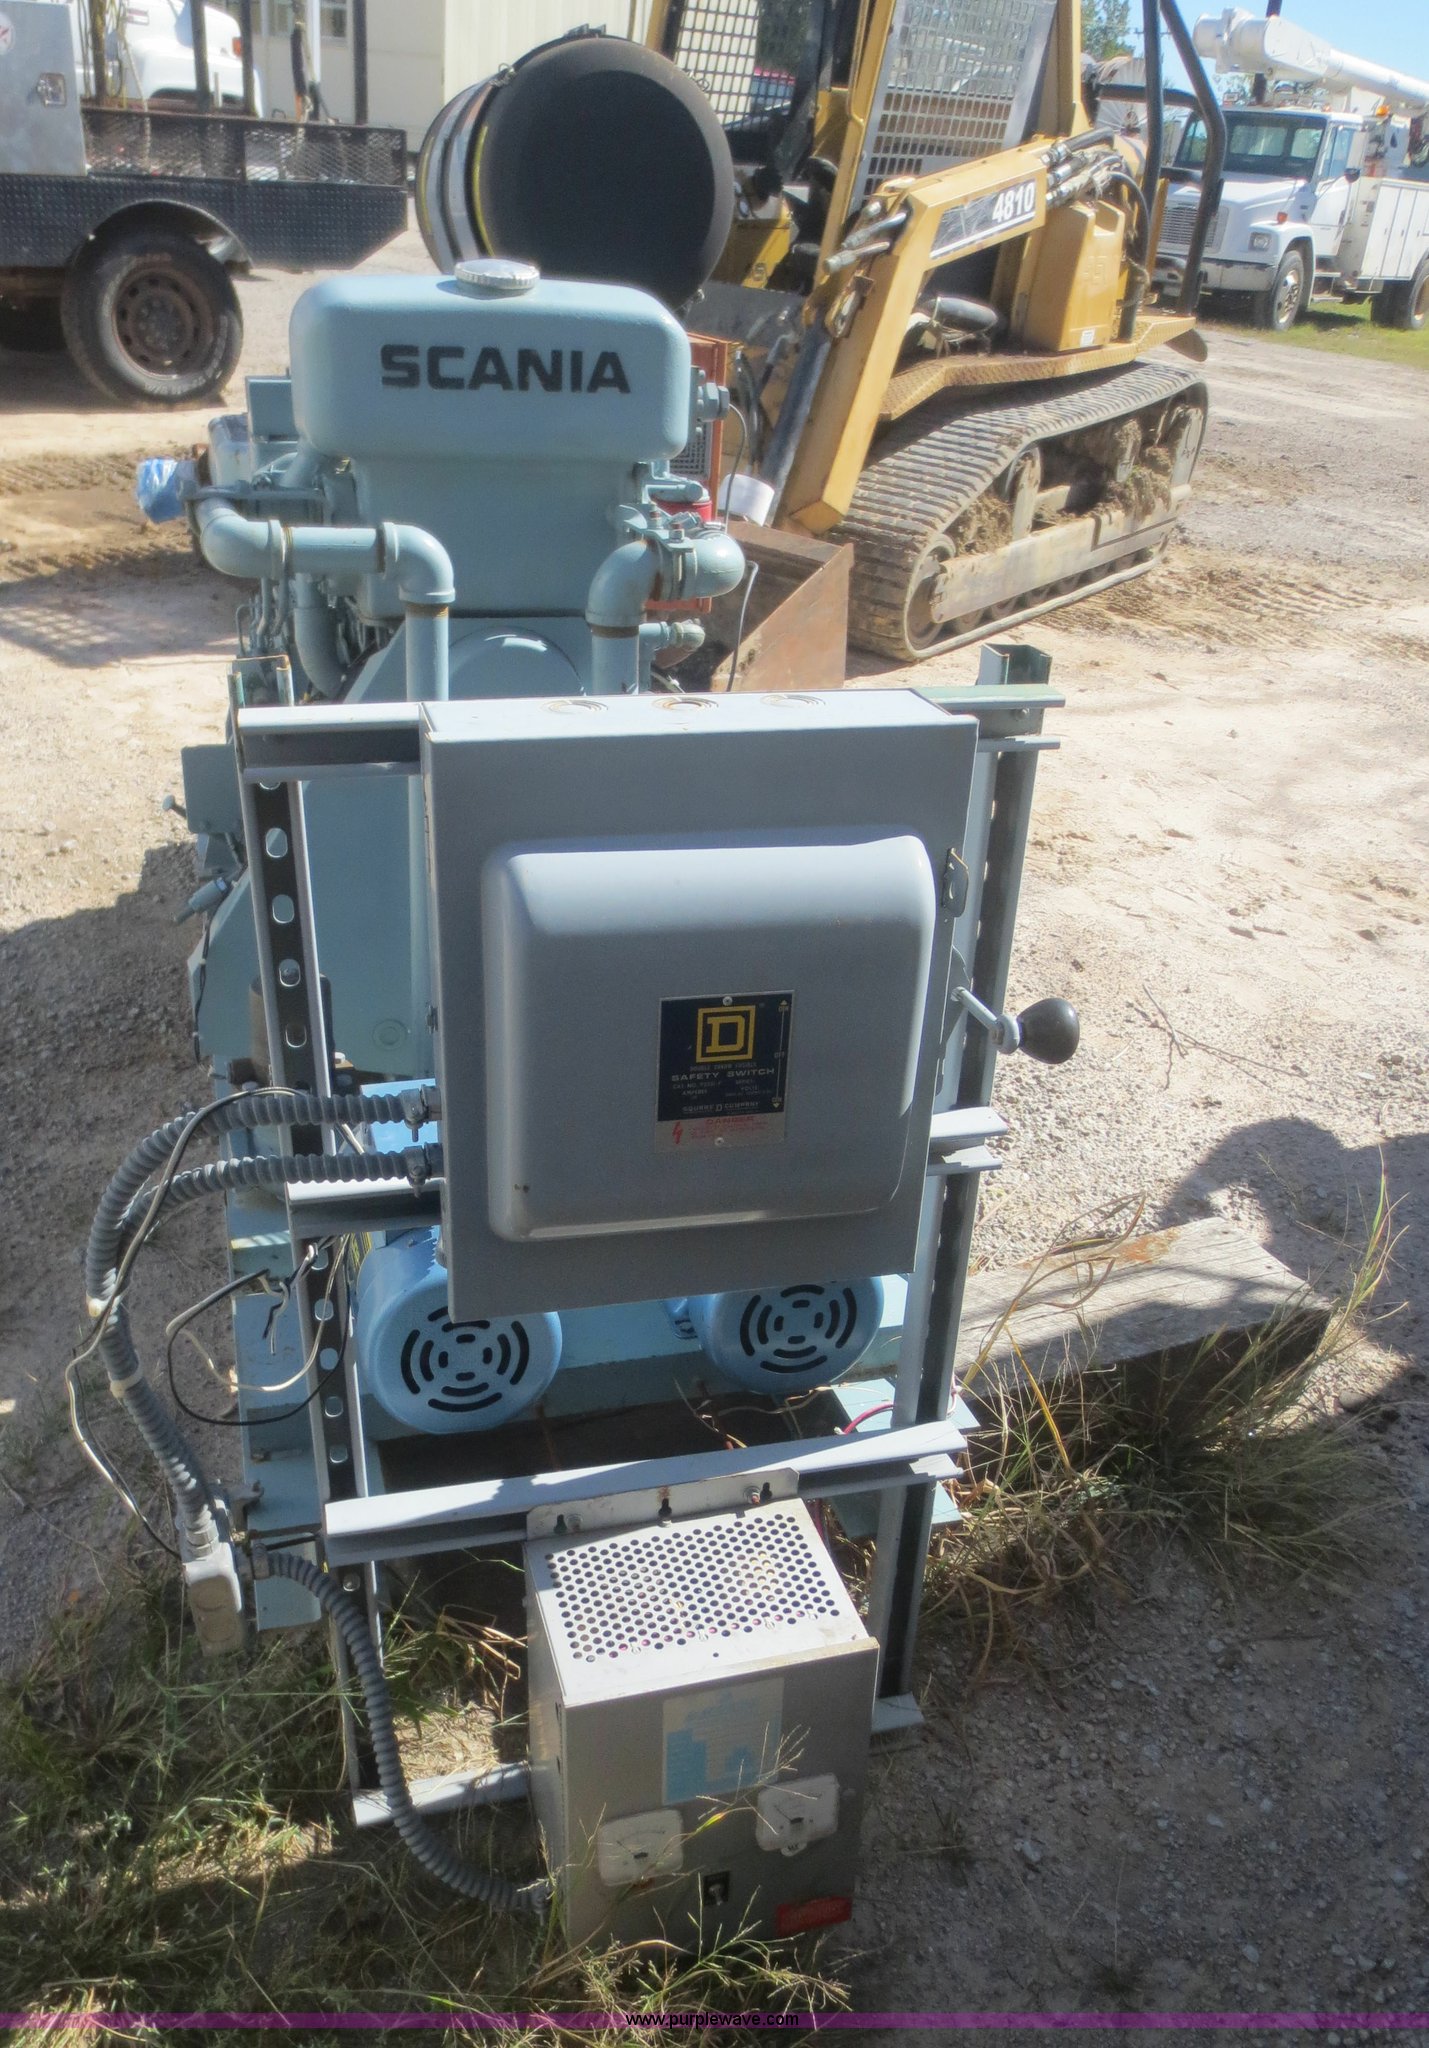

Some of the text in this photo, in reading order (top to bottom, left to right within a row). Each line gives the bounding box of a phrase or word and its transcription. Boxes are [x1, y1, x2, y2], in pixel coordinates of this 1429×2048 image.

[993, 182, 1035, 222] 4810
[381, 343, 631, 395] SCANIA
[671, 1067, 775, 1081] SAFETY SWITCH
[715, 1103, 723, 1112] D
